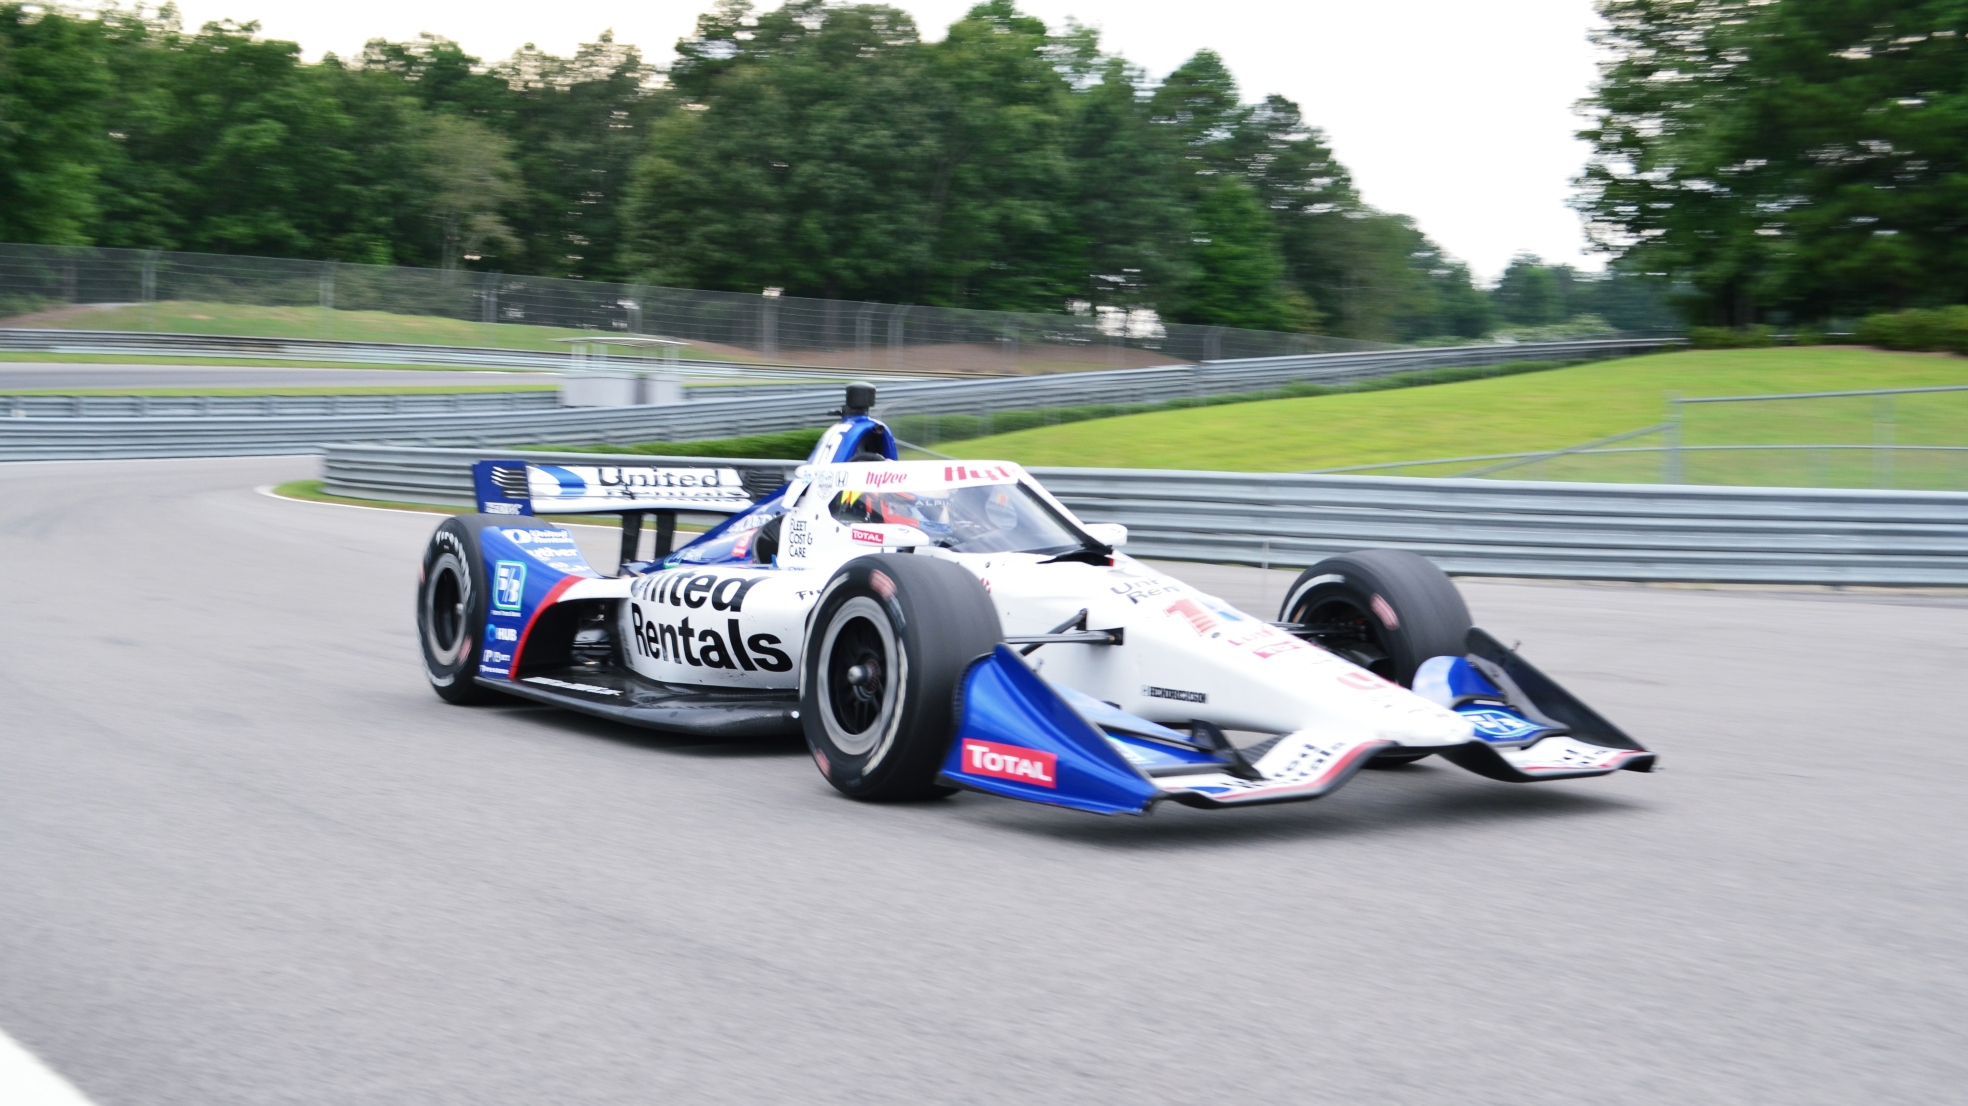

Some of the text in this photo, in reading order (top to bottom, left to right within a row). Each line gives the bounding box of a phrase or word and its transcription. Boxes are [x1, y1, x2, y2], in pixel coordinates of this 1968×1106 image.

[598, 467, 721, 488] United
[631, 602, 793, 673] Rentals
[965, 744, 1052, 782] TOTAL
